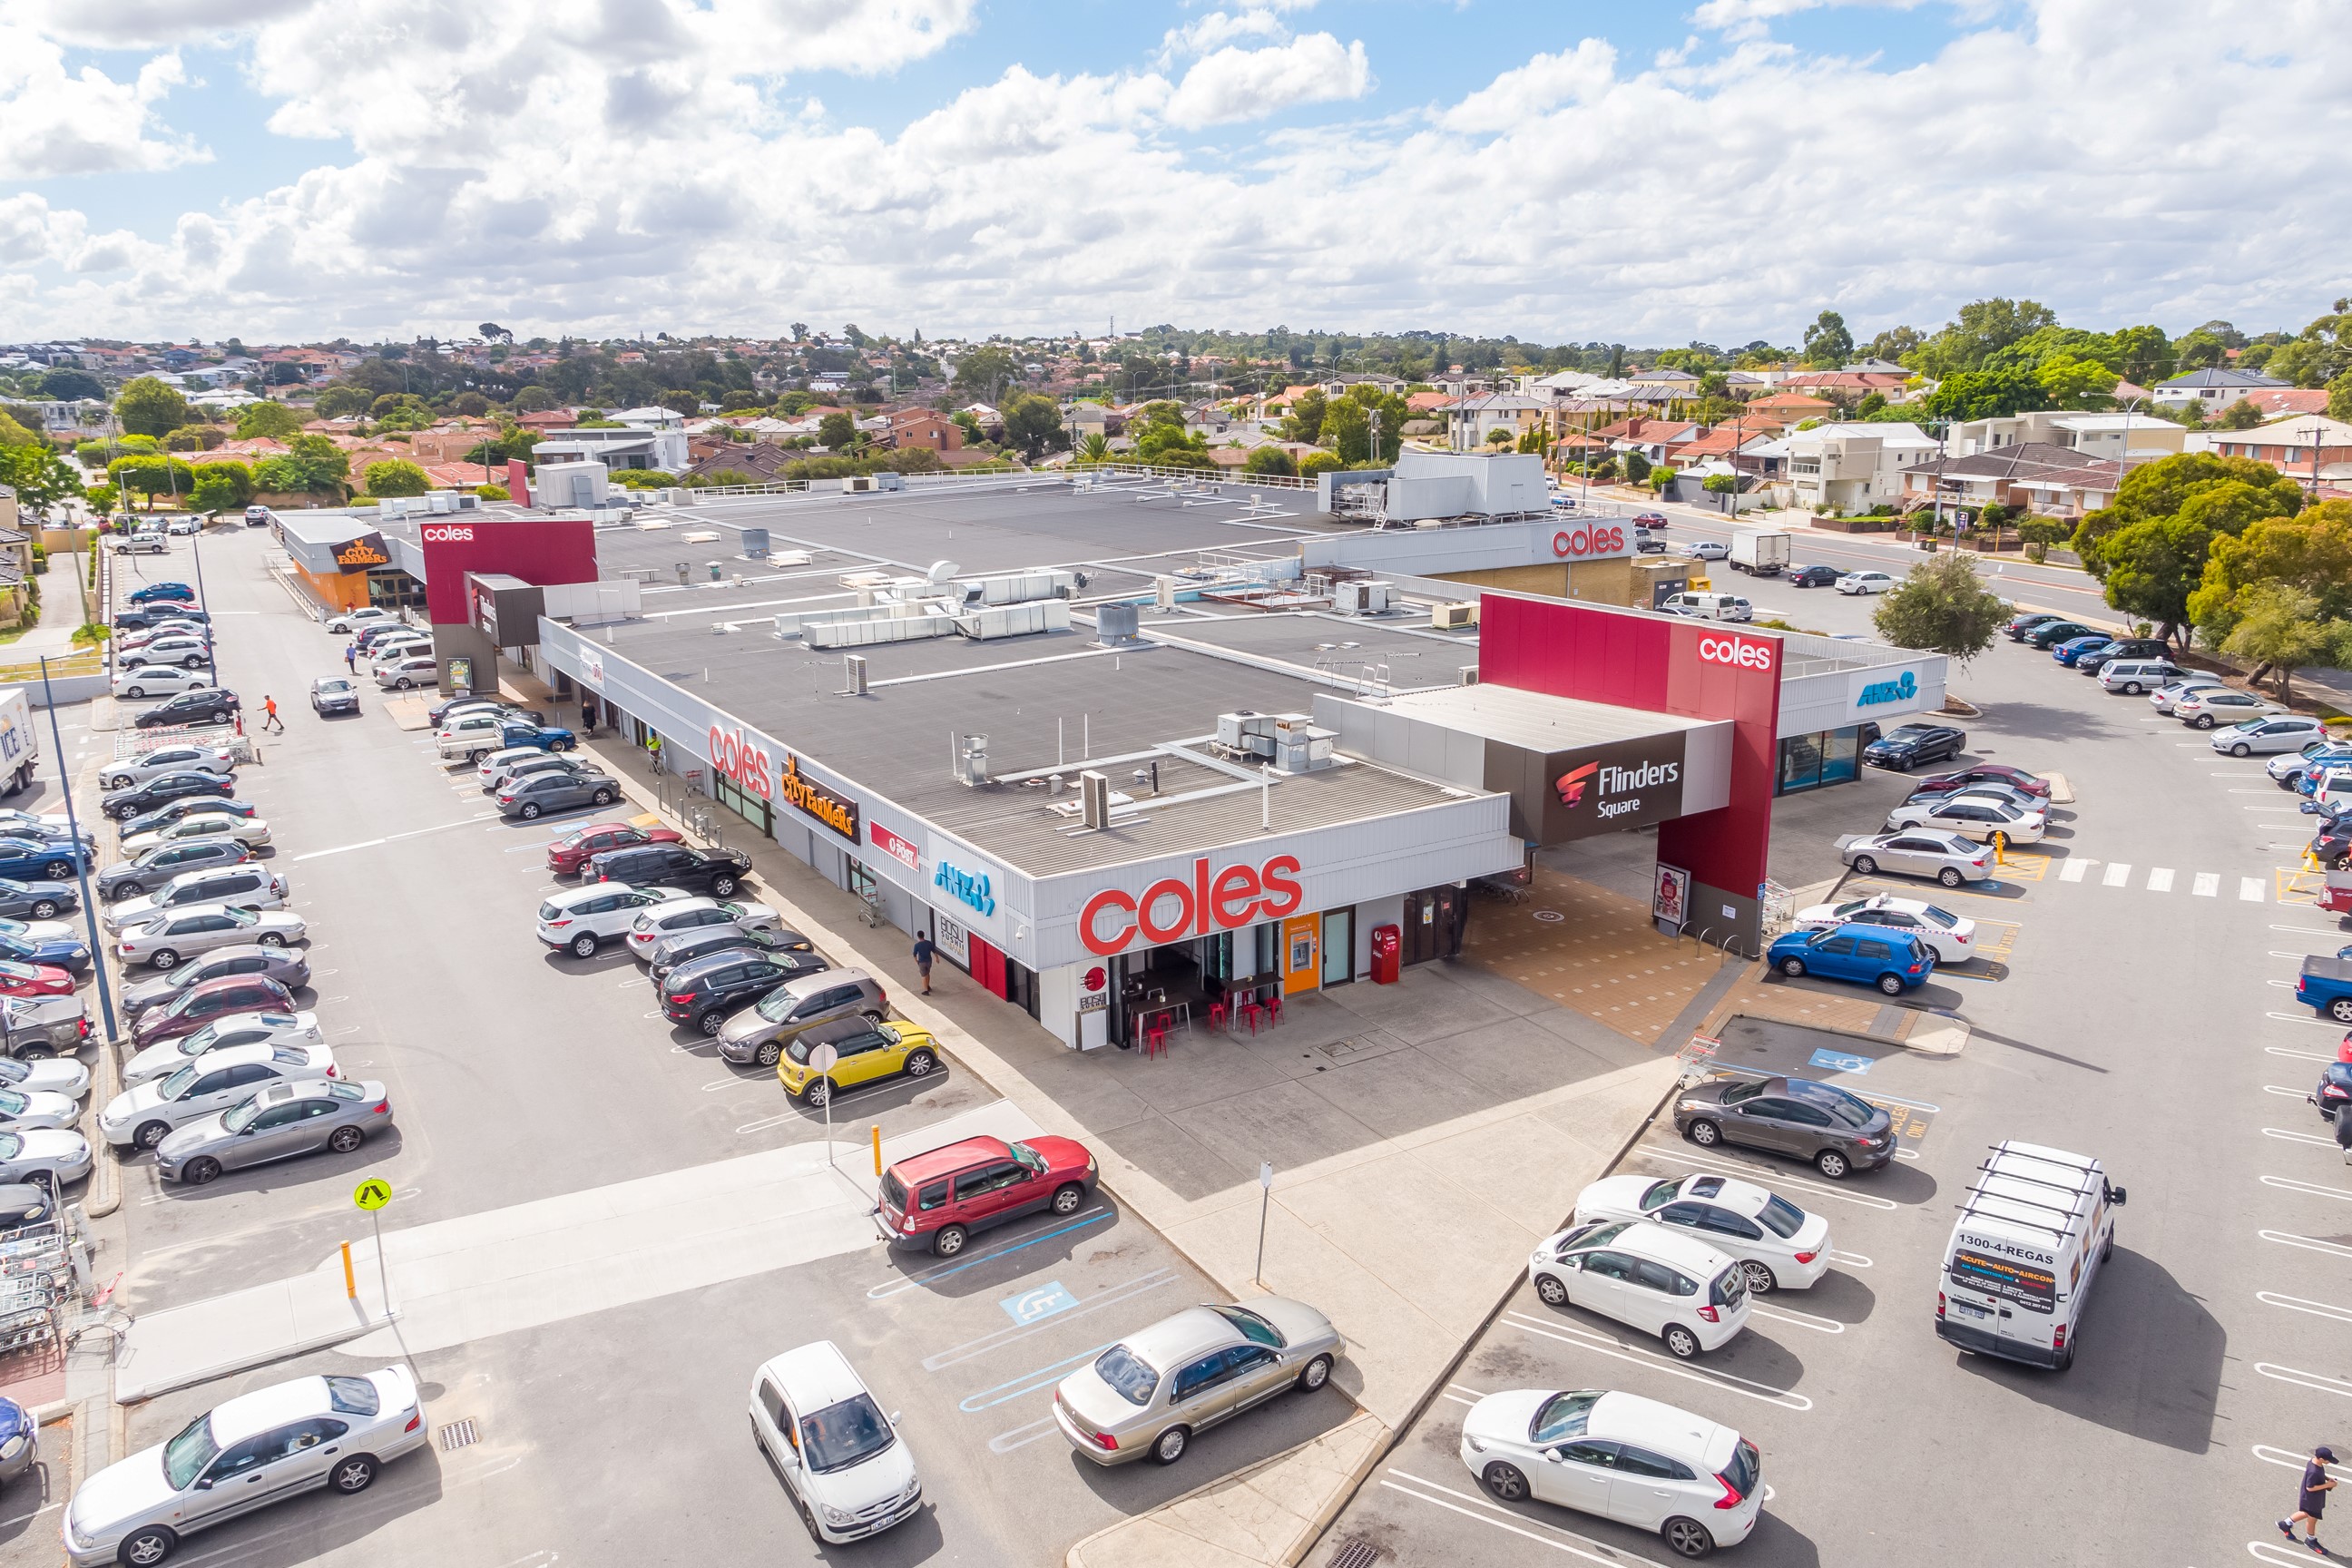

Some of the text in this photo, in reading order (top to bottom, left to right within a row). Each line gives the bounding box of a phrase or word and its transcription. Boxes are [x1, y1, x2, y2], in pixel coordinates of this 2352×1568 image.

[424, 525, 474, 542] coles
[1553, 524, 1624, 557] coles
[1700, 636, 1770, 669] coles
[1857, 681, 1899, 707] ANZ
[710, 725, 774, 800] coles
[1599, 760, 1679, 796] Flinders
[1598, 799, 1641, 818] Square
[896, 843, 916, 865] POST
[935, 860, 975, 906] ANZ
[1077, 853, 1303, 956] coles
[1906, 1119, 1928, 1138] ONLY
[1959, 1233, 2053, 1265] 1300-4-REGAS
